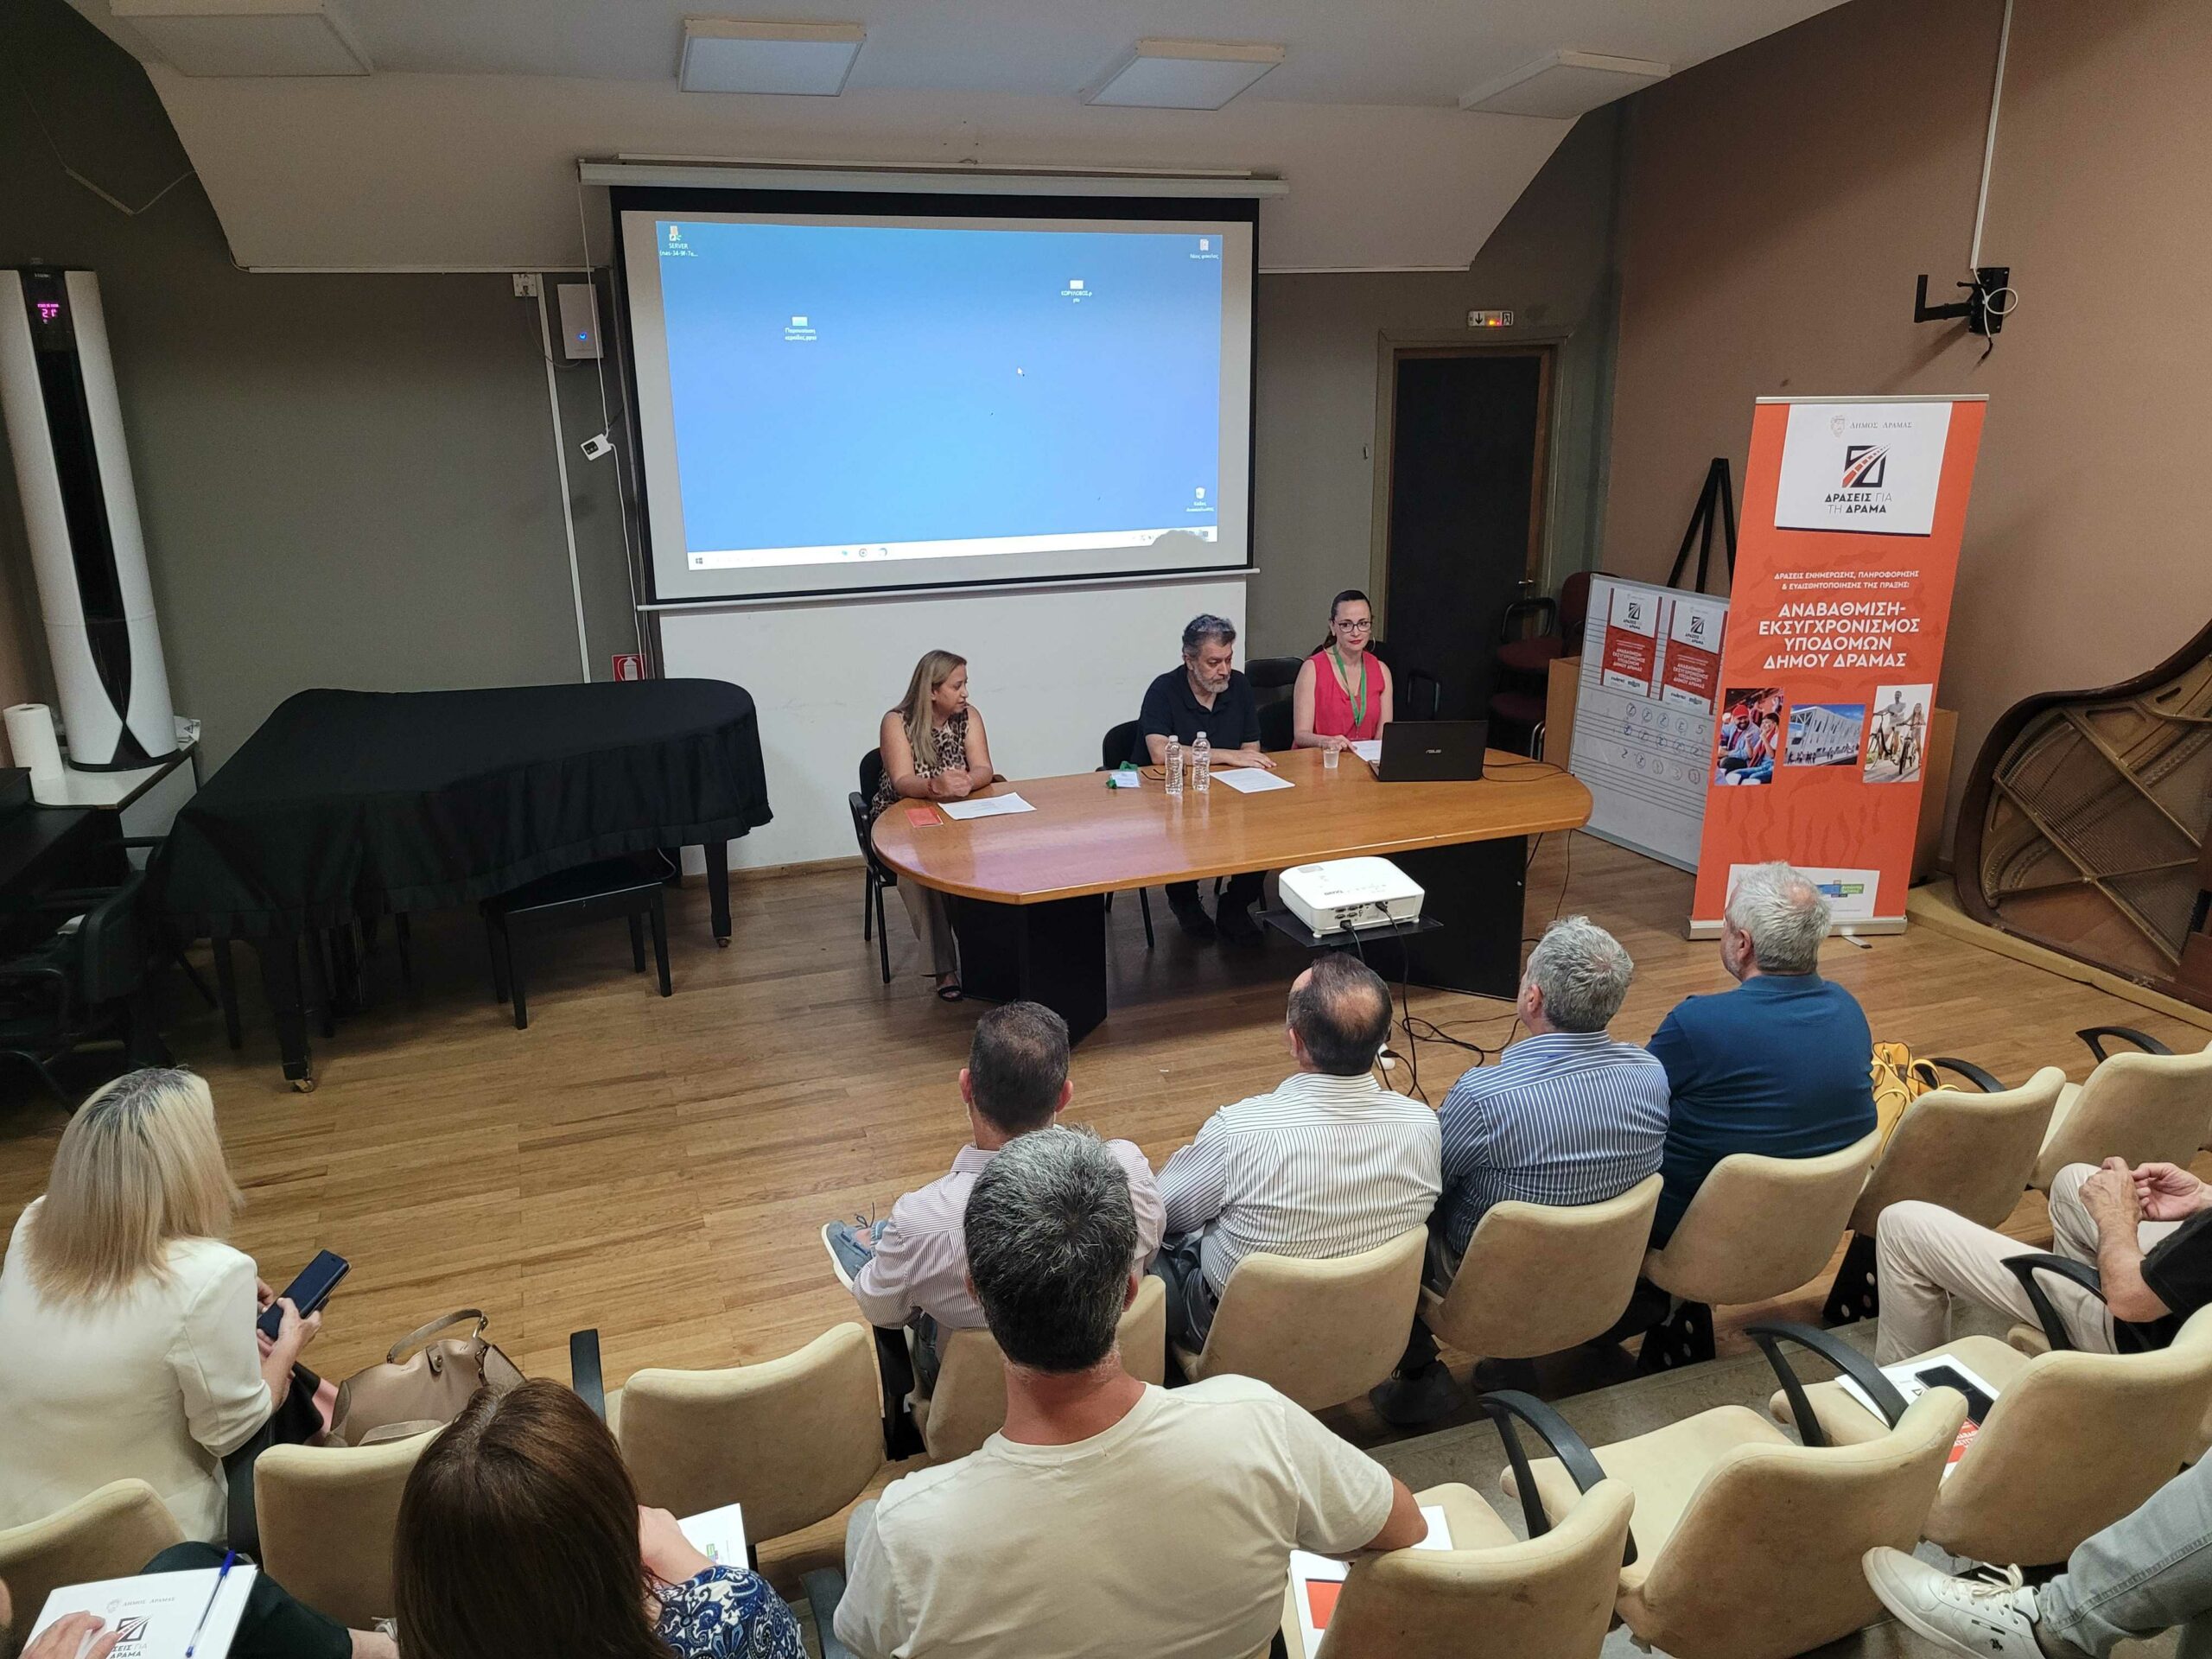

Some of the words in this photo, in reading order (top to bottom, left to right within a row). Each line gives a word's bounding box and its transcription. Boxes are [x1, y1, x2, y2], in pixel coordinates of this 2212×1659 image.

[1825, 493, 1872, 503] ΔΡΑΣΕΙΣ
[1875, 493, 1892, 502] ΓΙΑ
[1827, 505, 1842, 514] ΤΗ
[1846, 504, 1886, 514] ΔΡΑΜΑ
[1774, 571, 1804, 580] ΔΡΑΣΕΙΣ
[1778, 601, 1906, 618] ΑΝΑΒΑΘΜΙΣΗ-
[1758, 618, 1920, 635] ΕΚΣΥΓΧΡΟΝΙΣΜΟΣ
[1784, 636, 1892, 652] ΥΠΟΔΟΜΩΝ
[1763, 653, 1830, 669] ΔΗΜΟΥ
[1833, 652, 1907, 668] ΔΡΑΜΑΣ
[111, 1644, 132, 1653] ΣΕΙΣ
